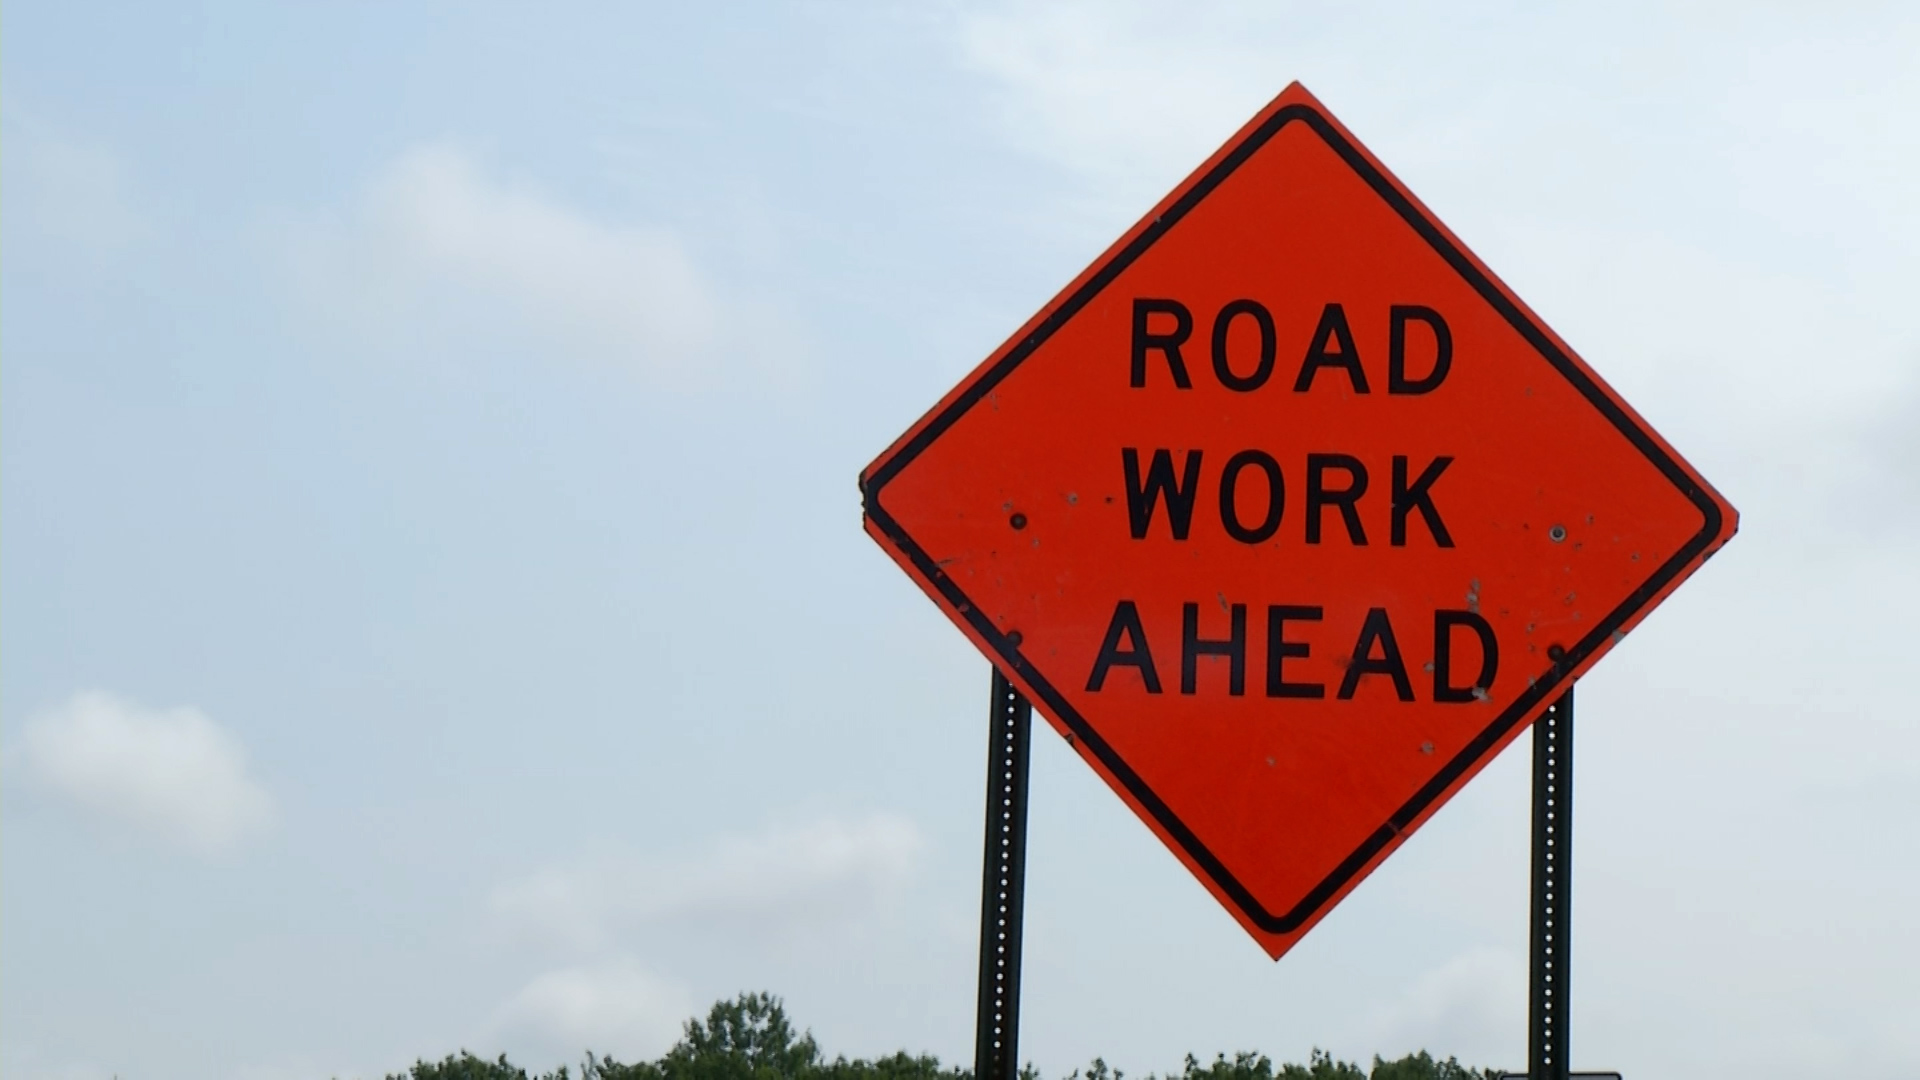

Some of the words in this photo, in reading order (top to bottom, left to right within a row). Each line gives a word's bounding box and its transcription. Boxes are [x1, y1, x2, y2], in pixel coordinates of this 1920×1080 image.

[1130, 297, 1454, 396] ROAD
[1121, 447, 1456, 549] WORK
[1084, 600, 1500, 704] AHEAD
